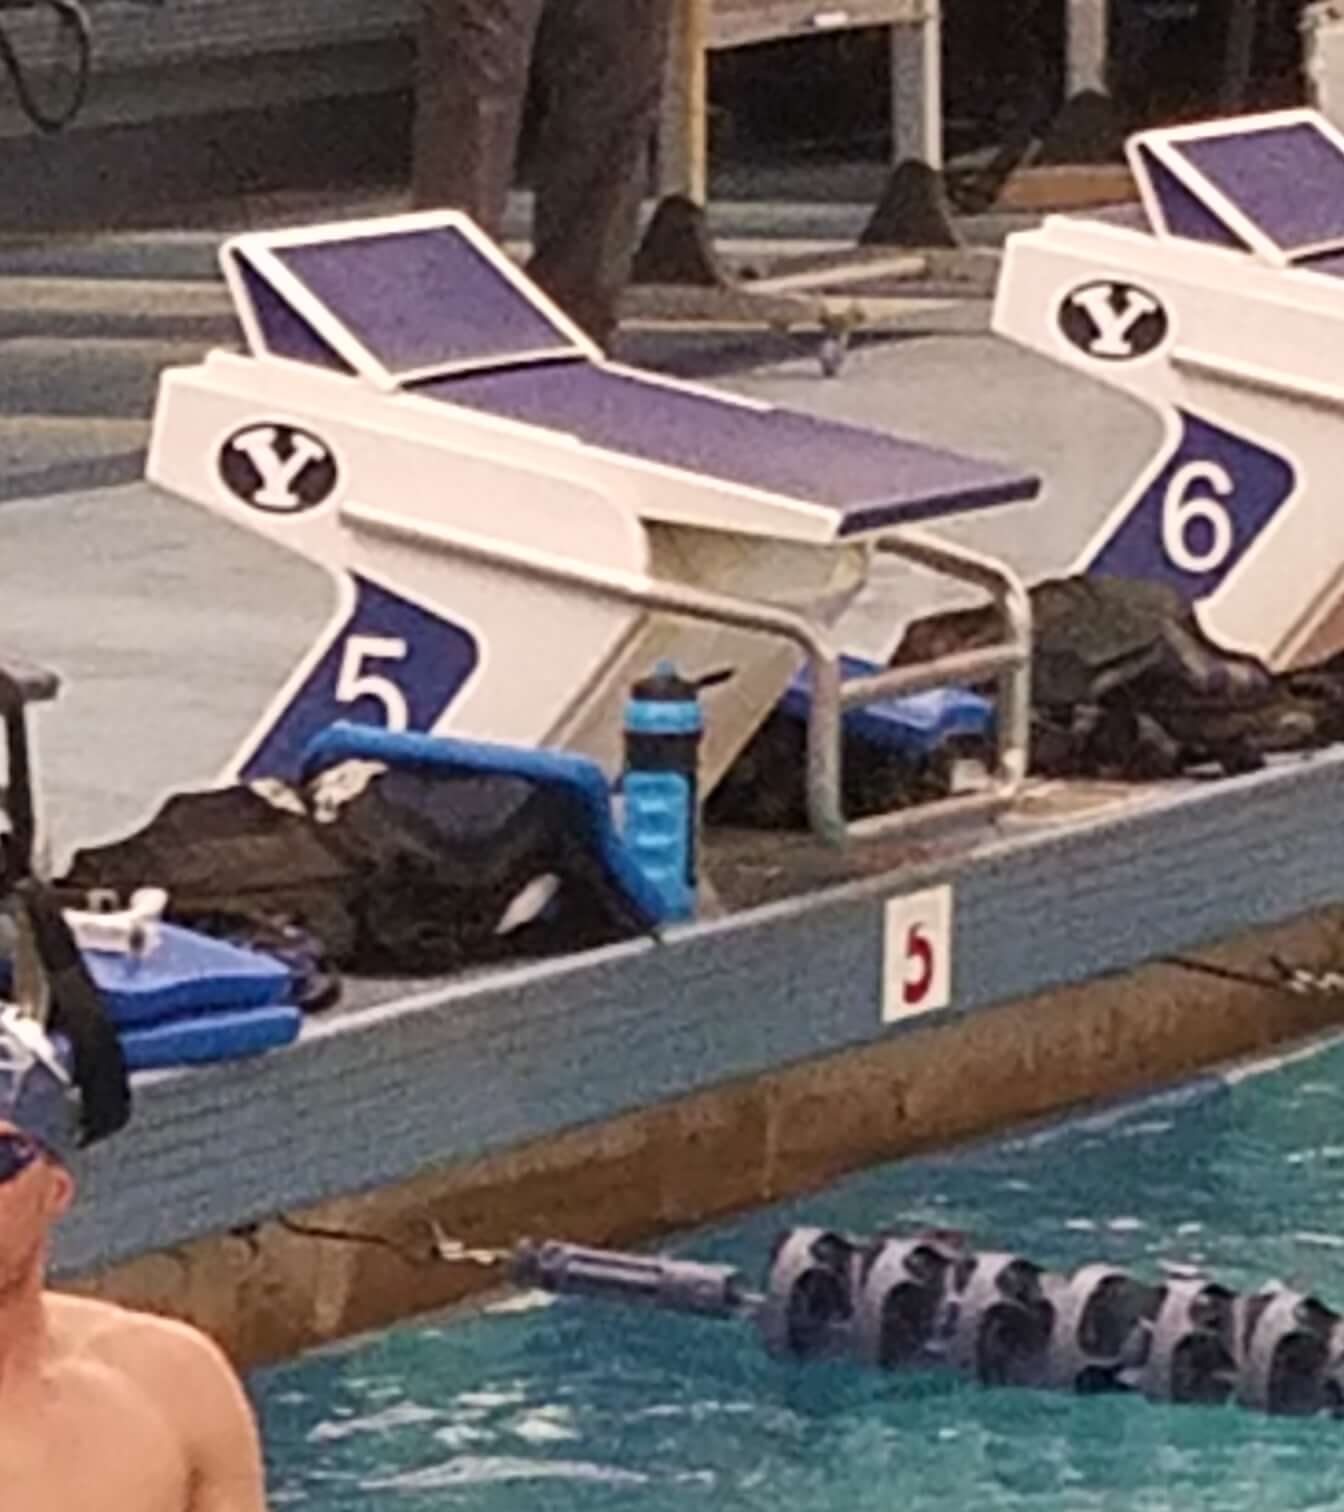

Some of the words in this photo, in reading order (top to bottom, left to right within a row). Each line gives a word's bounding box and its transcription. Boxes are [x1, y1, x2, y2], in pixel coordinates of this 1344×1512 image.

[1071, 284, 1158, 356] Y
[232, 428, 325, 509] Y
[1163, 460, 1235, 573] 6
[335, 636, 407, 735] 5
[902, 921, 935, 1005] 5
